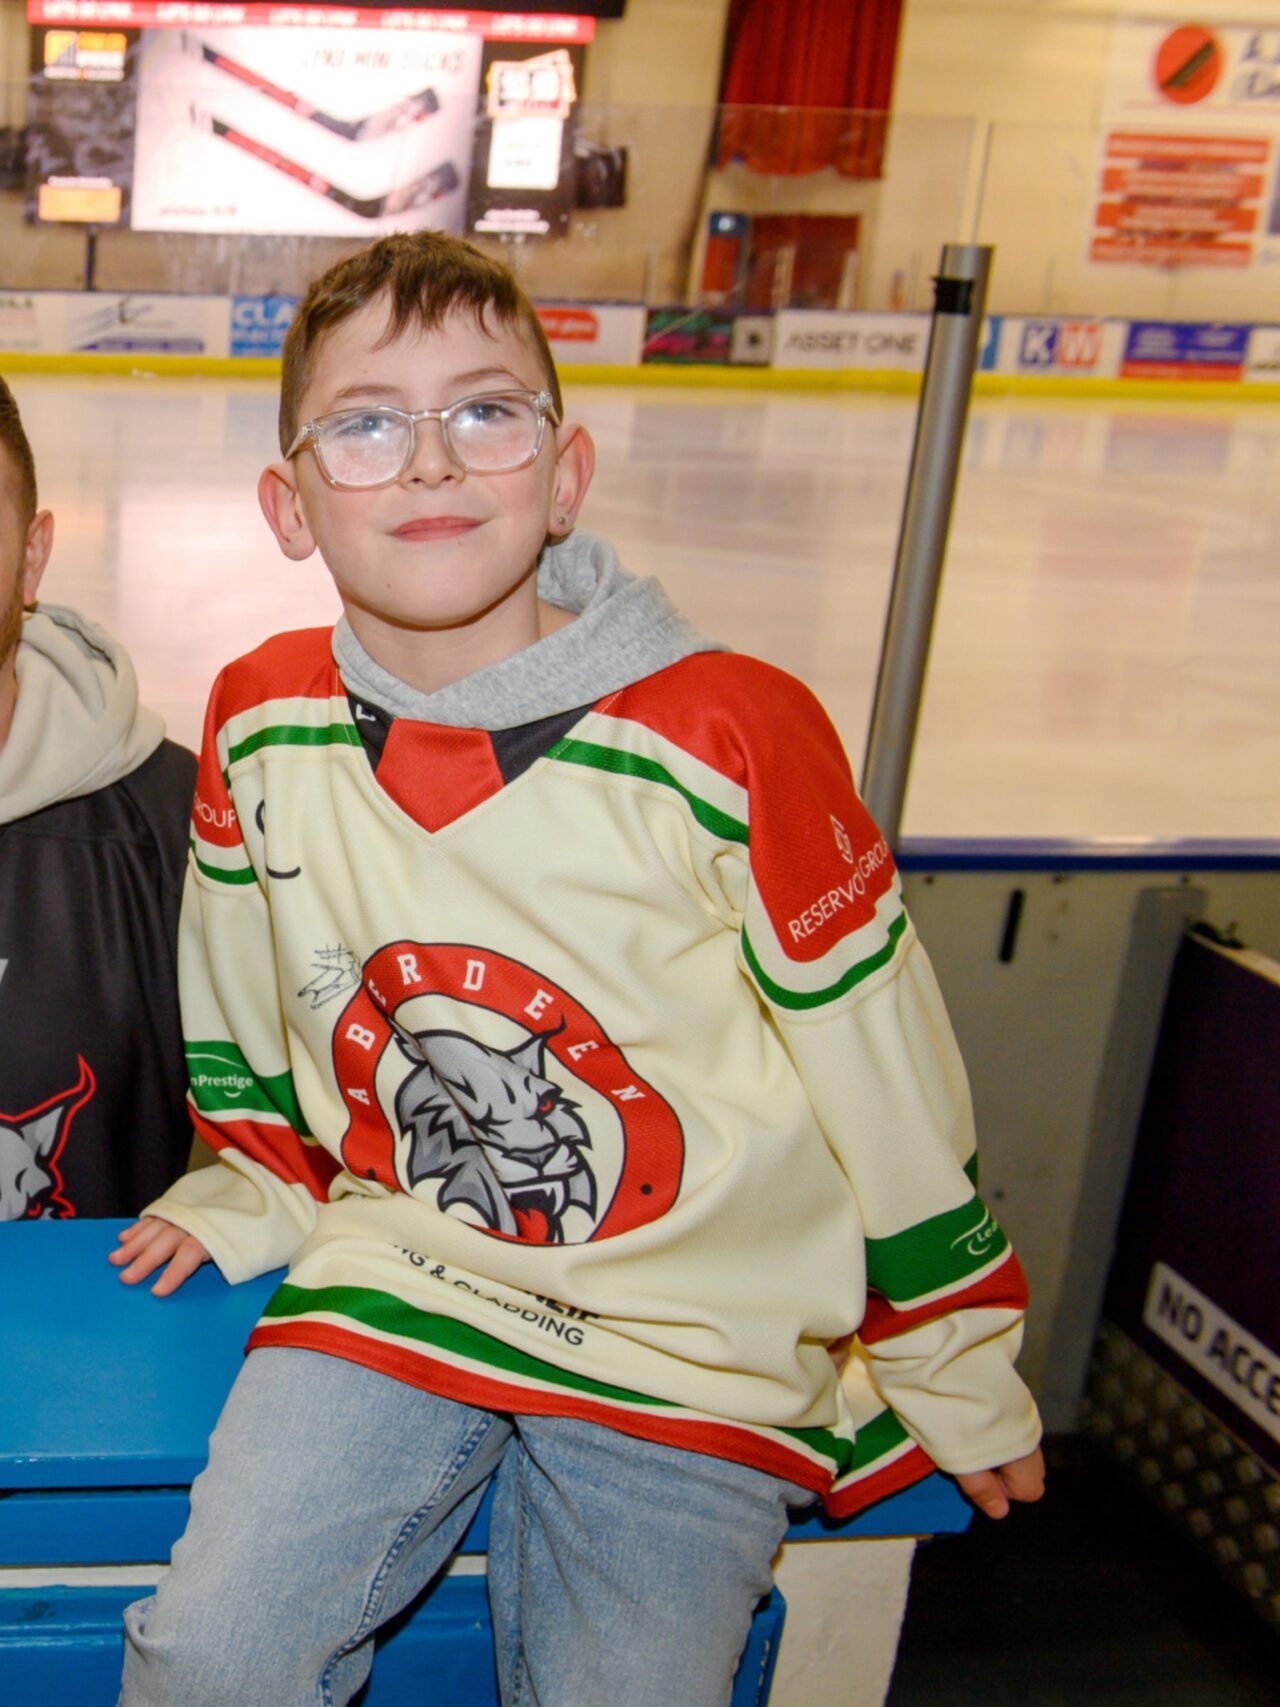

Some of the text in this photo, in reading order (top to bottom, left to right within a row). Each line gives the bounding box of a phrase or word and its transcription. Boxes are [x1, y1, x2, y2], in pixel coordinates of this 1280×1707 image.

[236, 302, 293, 325] CLA
[785, 331, 917, 356] ASSET ONE
[346, 952, 646, 1106] ABERDEEN
[190, 1073, 254, 1090] nPrestige
[430, 1264, 446, 1281] &
[1157, 1282, 1280, 1415] NO ACCE
